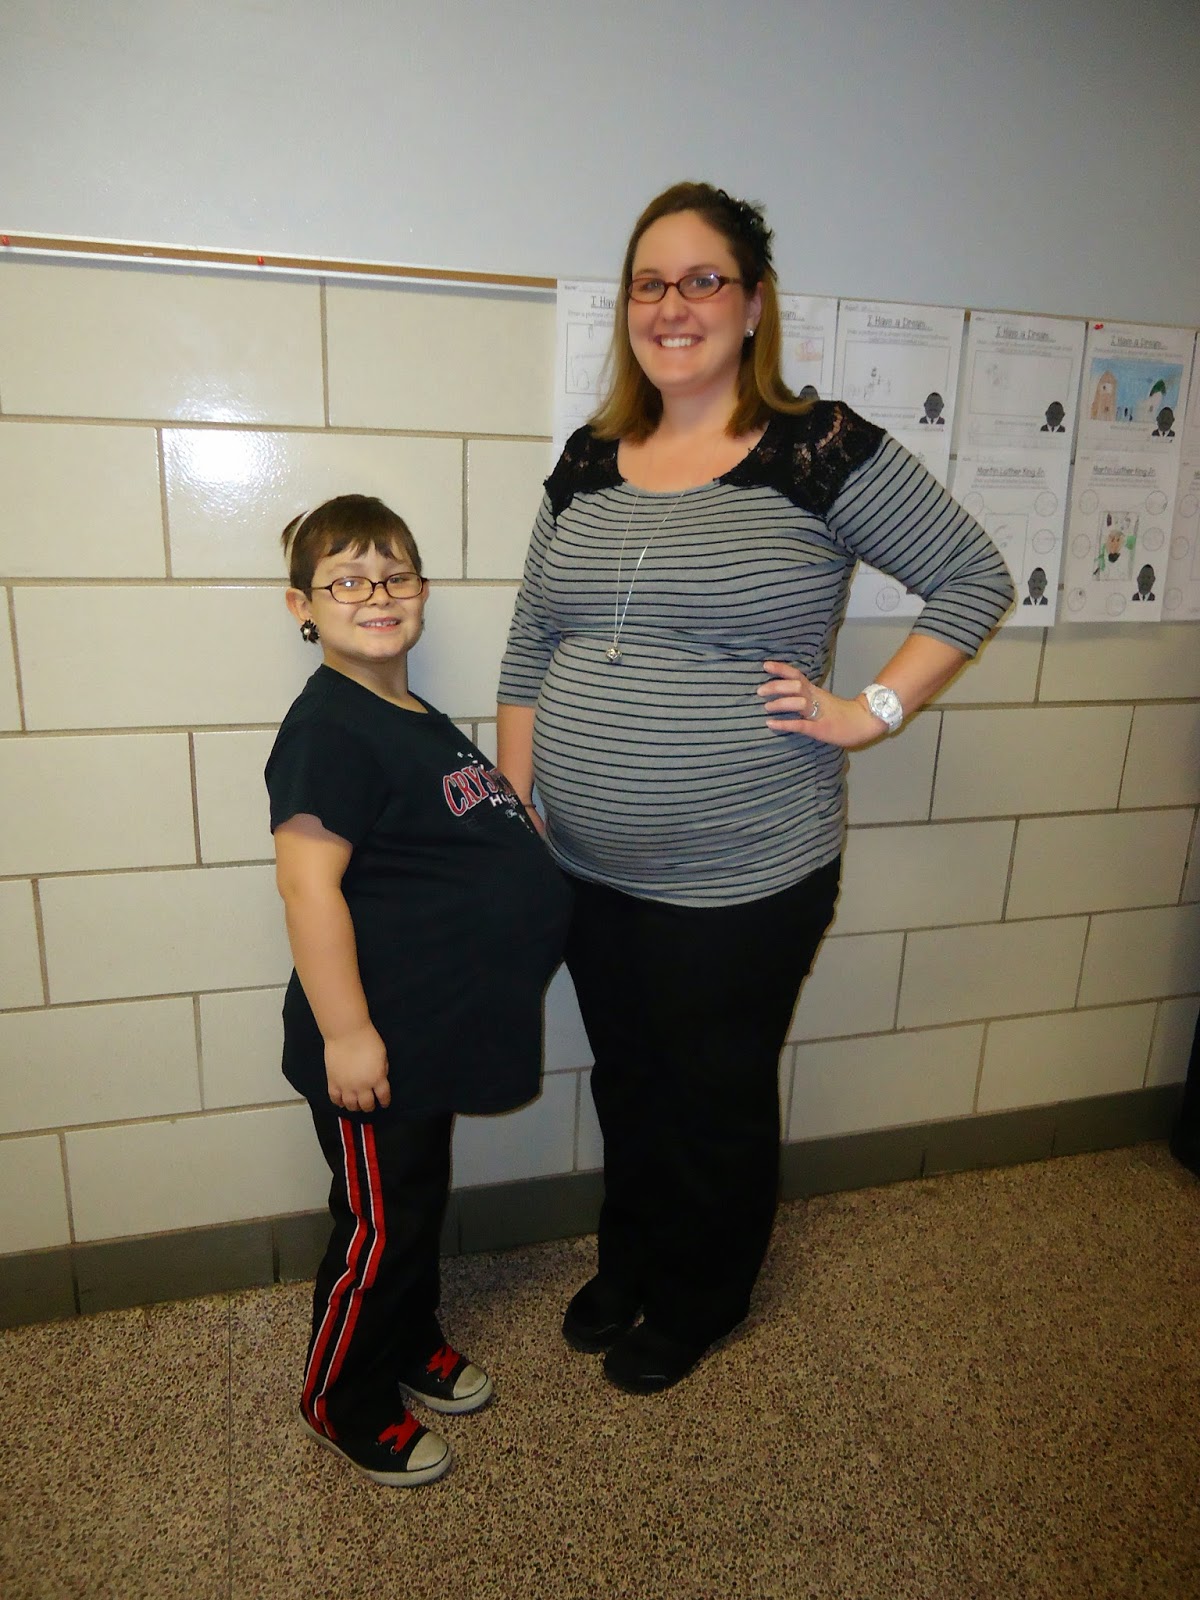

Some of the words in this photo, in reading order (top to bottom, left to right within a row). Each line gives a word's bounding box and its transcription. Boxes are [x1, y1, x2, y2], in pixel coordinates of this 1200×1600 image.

[600, 296, 615, 309] Hav
[875, 316, 892, 328] Have
[1002, 327, 1018, 339] Have
[1118, 336, 1133, 348] Have
[977, 467, 999, 477] Martin
[1001, 467, 1021, 477] Luther
[1023, 468, 1036, 478] King
[1093, 466, 1112, 476] Martin
[1114, 467, 1134, 477] Luther
[1135, 468, 1148, 478] King
